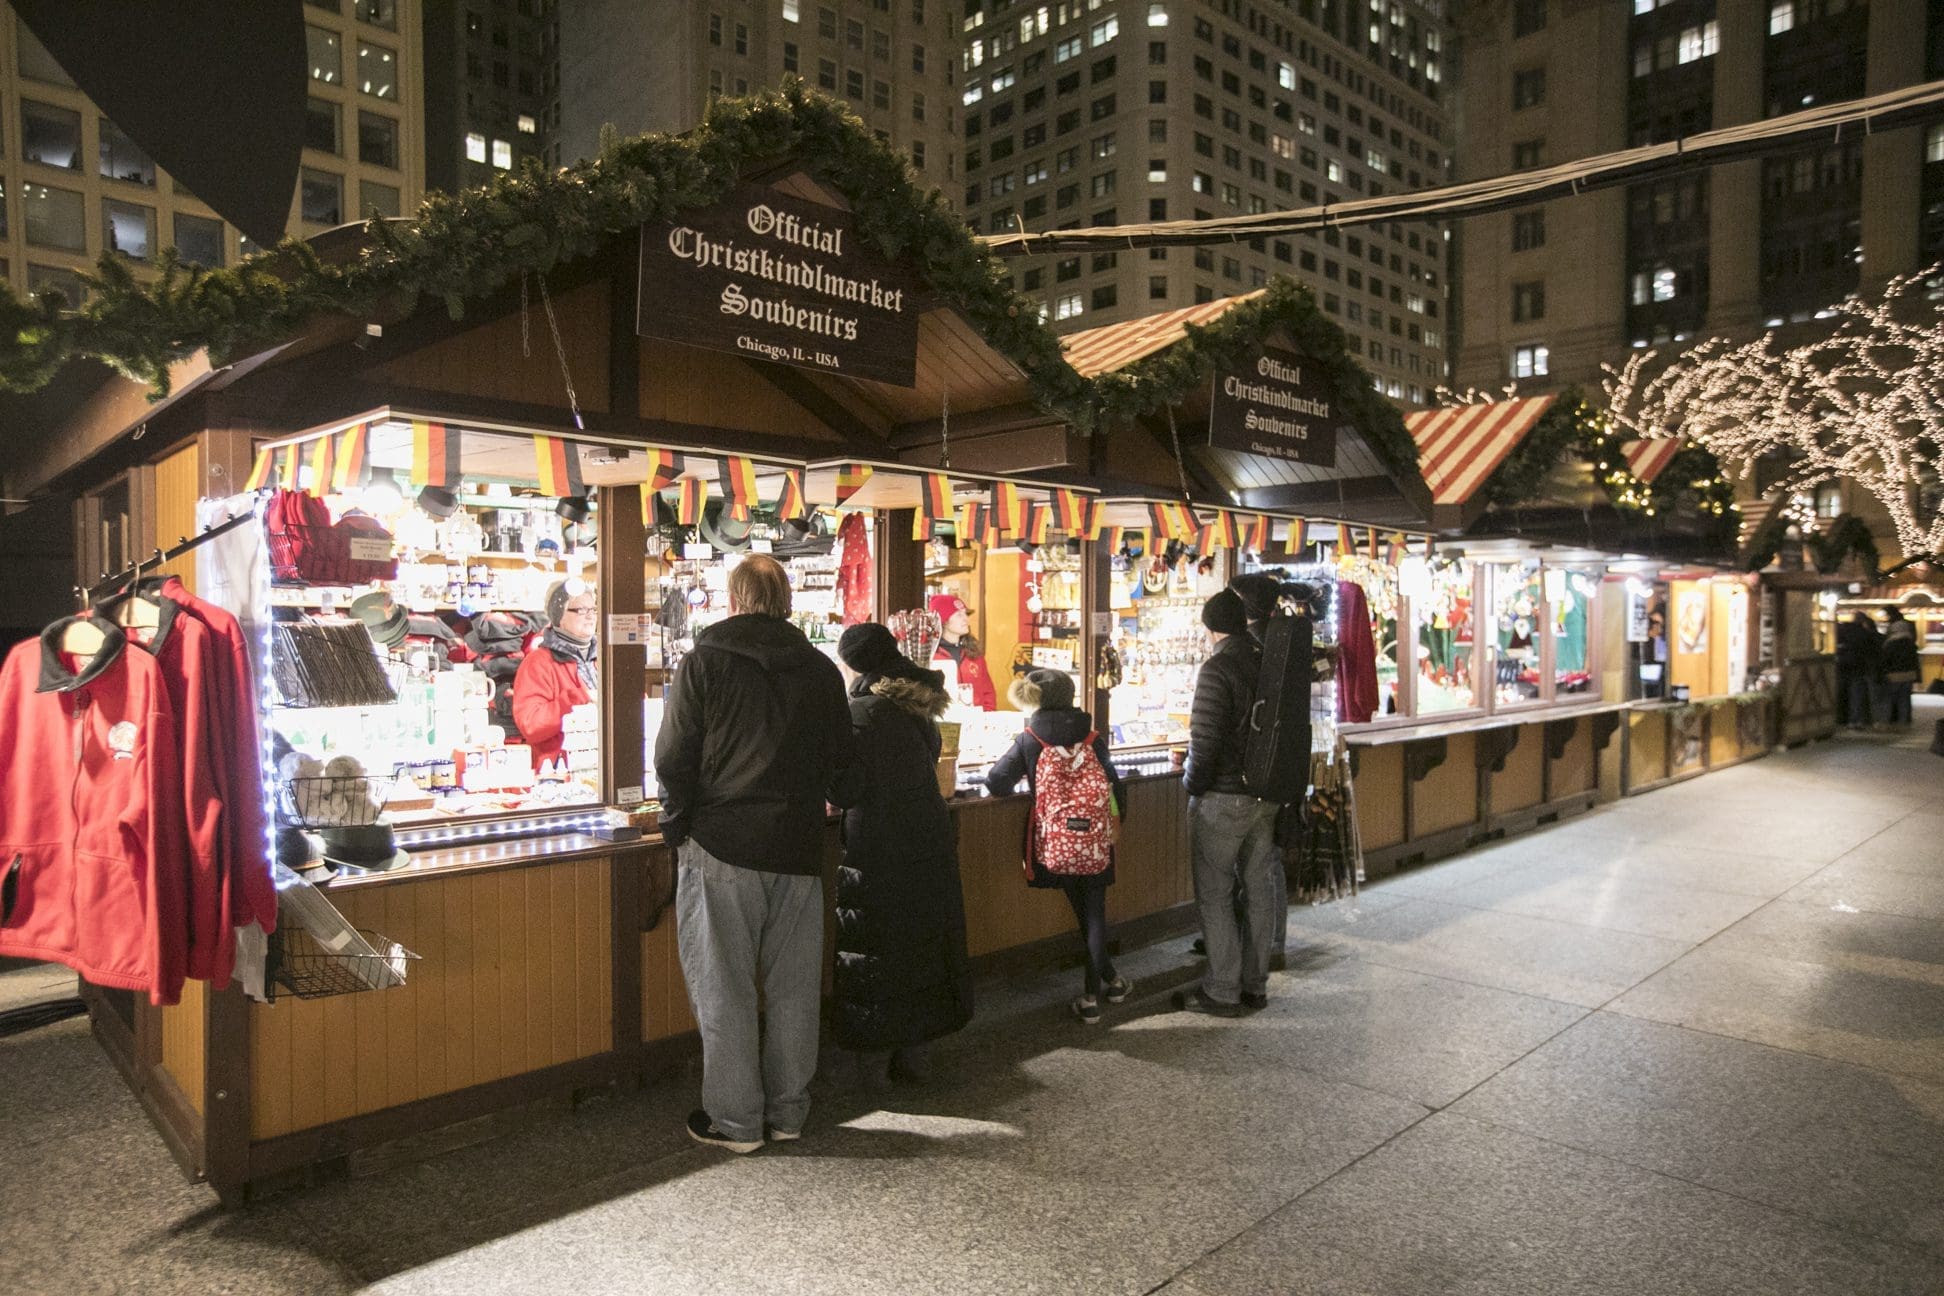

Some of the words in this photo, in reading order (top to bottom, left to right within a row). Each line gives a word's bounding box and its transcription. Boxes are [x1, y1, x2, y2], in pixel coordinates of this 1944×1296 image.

[747, 204, 843, 257] Official
[668, 226, 903, 313] Christkindlmarket
[720, 283, 858, 341] Souvenirs
[736, 336, 790, 360] Chicago,
[792, 347, 805, 361] IL
[815, 352, 839, 368] USA
[1257, 356, 1300, 385] Official
[1224, 376, 1329, 418] Christkindlmarket
[1244, 408, 1308, 440] Souvenirs
